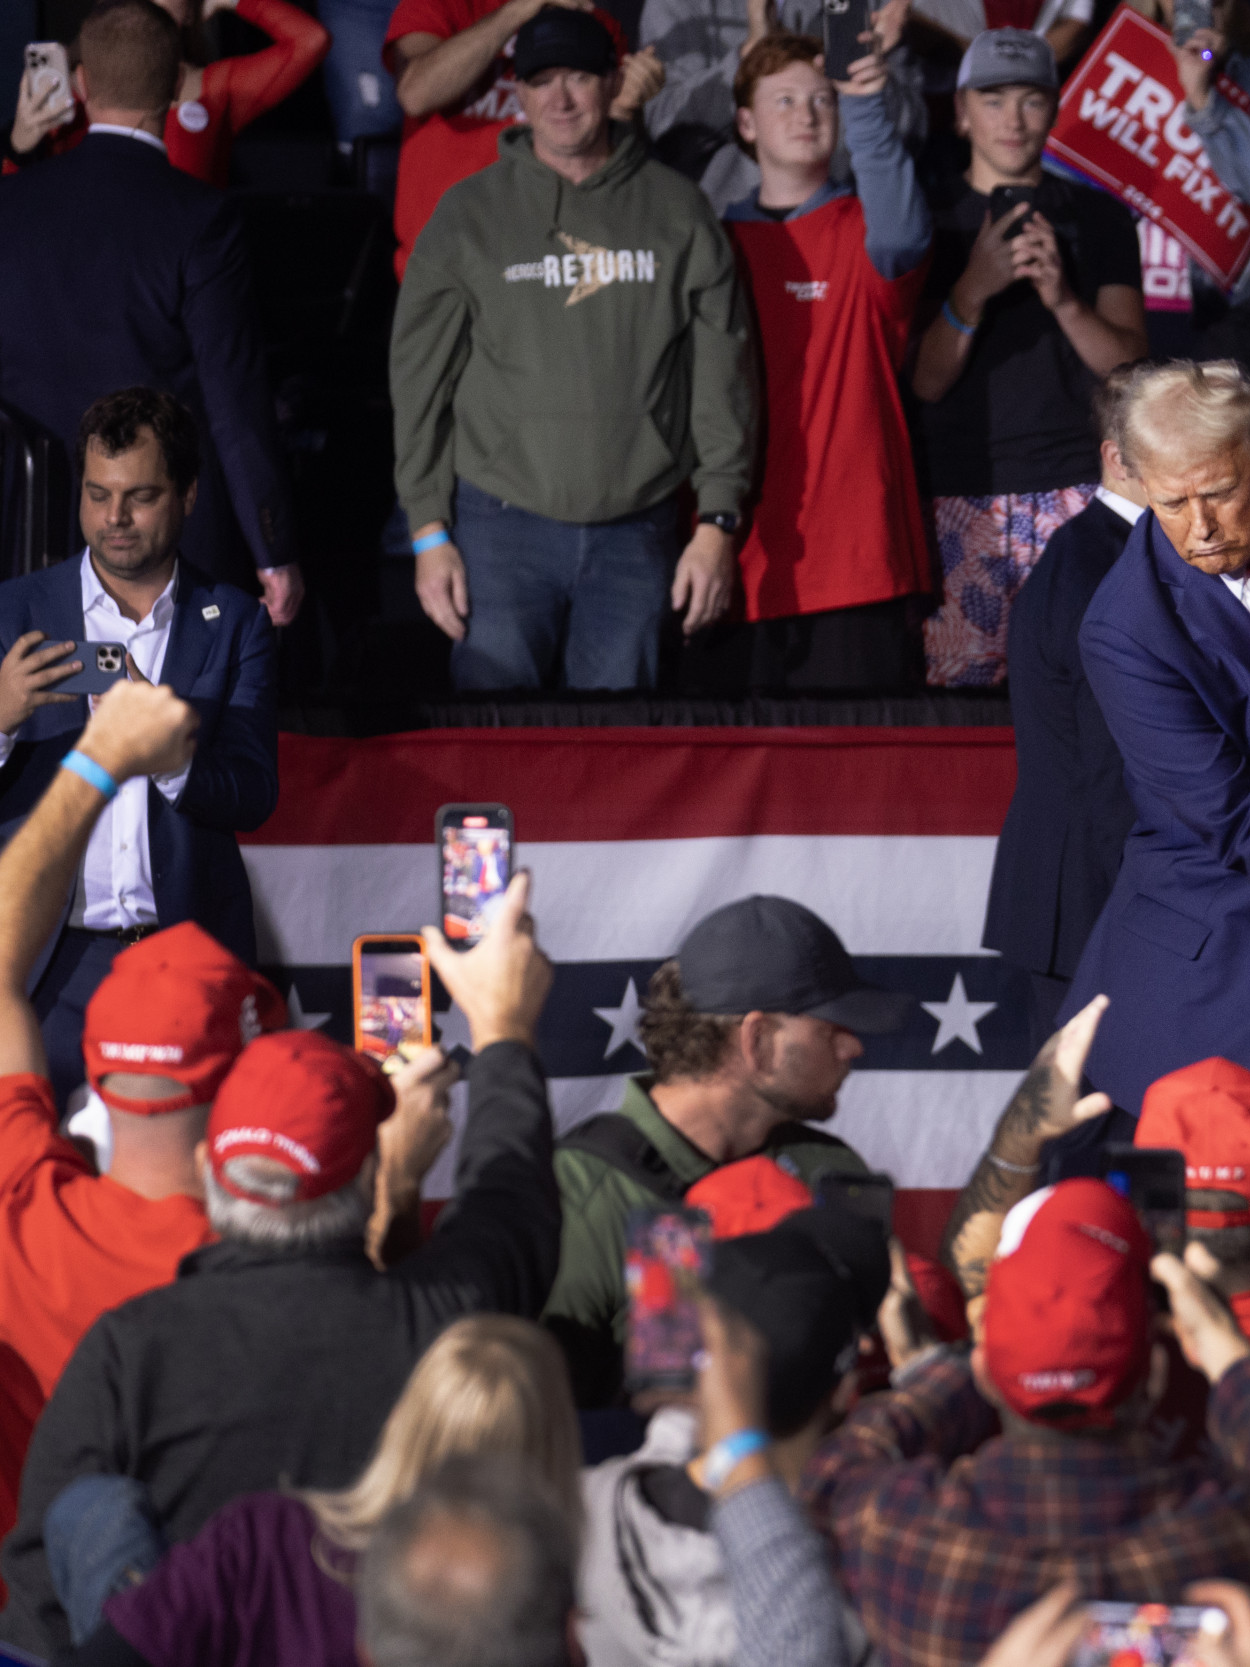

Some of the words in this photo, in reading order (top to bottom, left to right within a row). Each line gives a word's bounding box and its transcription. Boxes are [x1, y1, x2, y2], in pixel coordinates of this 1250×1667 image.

[1103, 51, 1211, 170] TRU
[1078, 88, 1160, 168] WILL
[1162, 152, 1222, 214] FIX
[1215, 196, 1249, 241] IT
[544, 249, 656, 289] RETURN
[1186, 1165, 1244, 1181] RUMP
